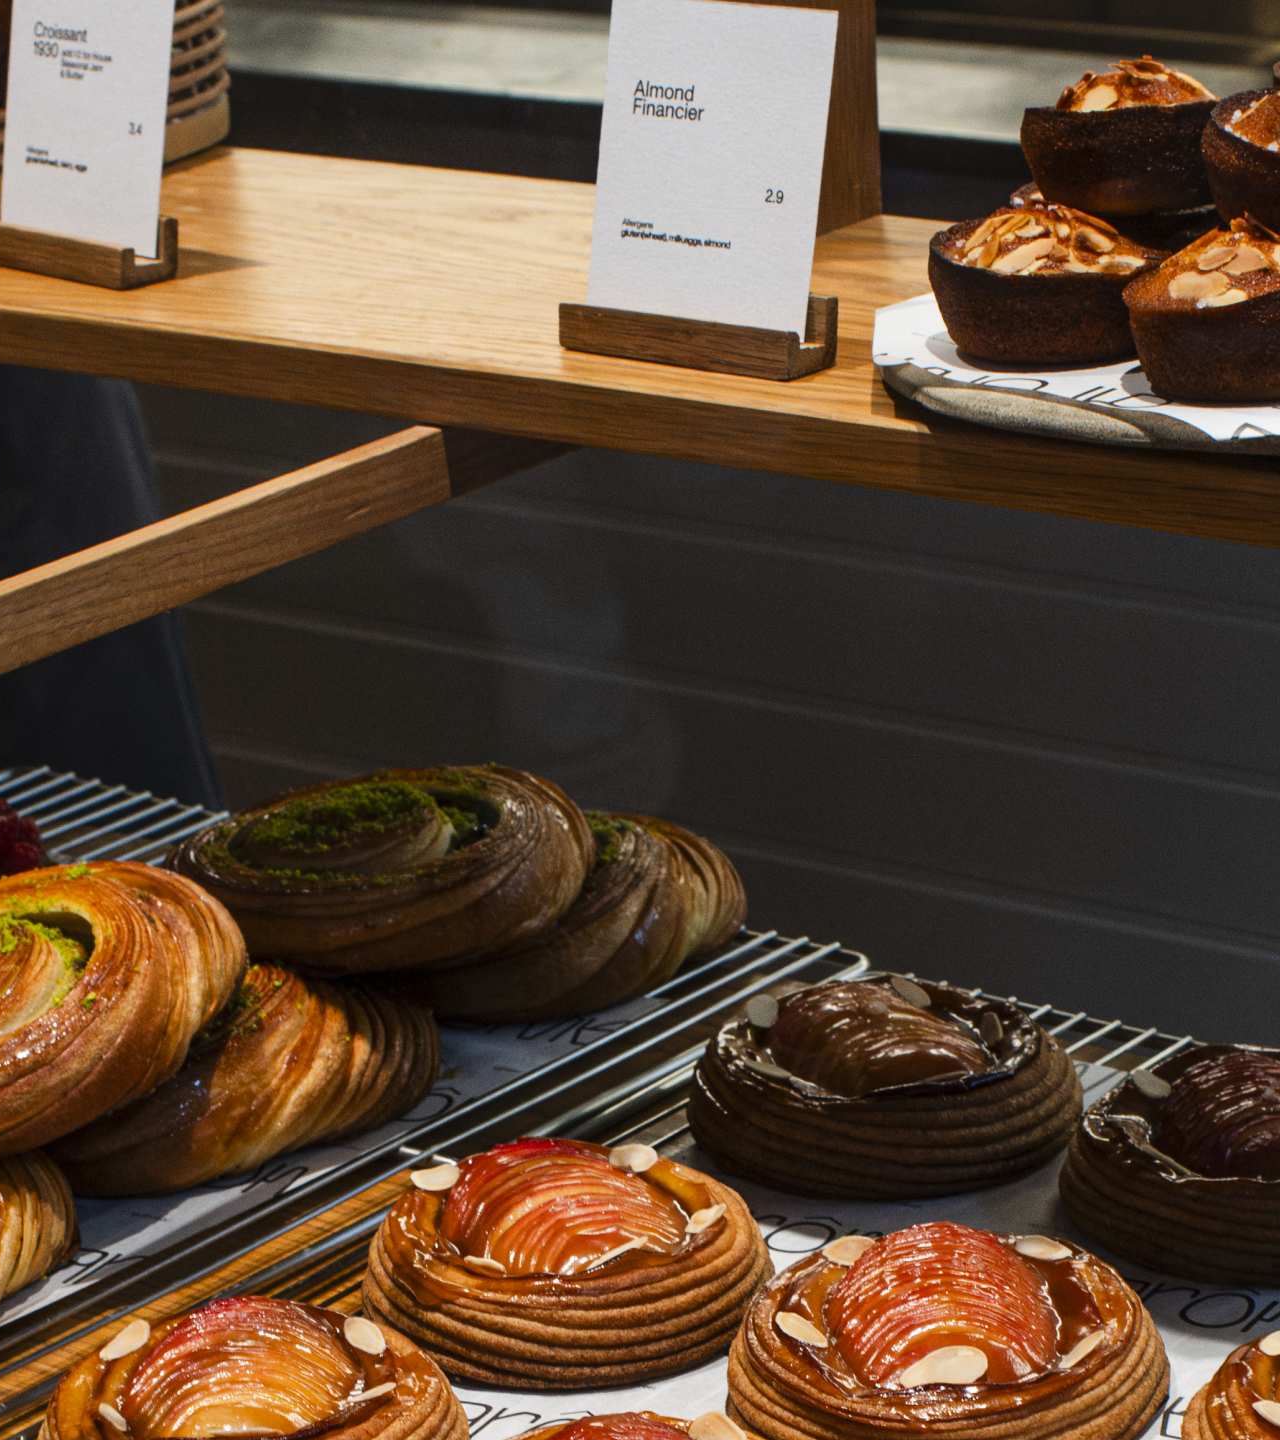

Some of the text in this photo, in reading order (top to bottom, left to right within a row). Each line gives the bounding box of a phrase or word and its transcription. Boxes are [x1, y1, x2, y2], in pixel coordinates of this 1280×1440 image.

[33, 21, 88, 43] Croissant
[33, 41, 59, 58] 1930
[634, 79, 695, 101] Almond
[632, 98, 705, 121] Financier
[764, 188, 785, 205] 2.9
